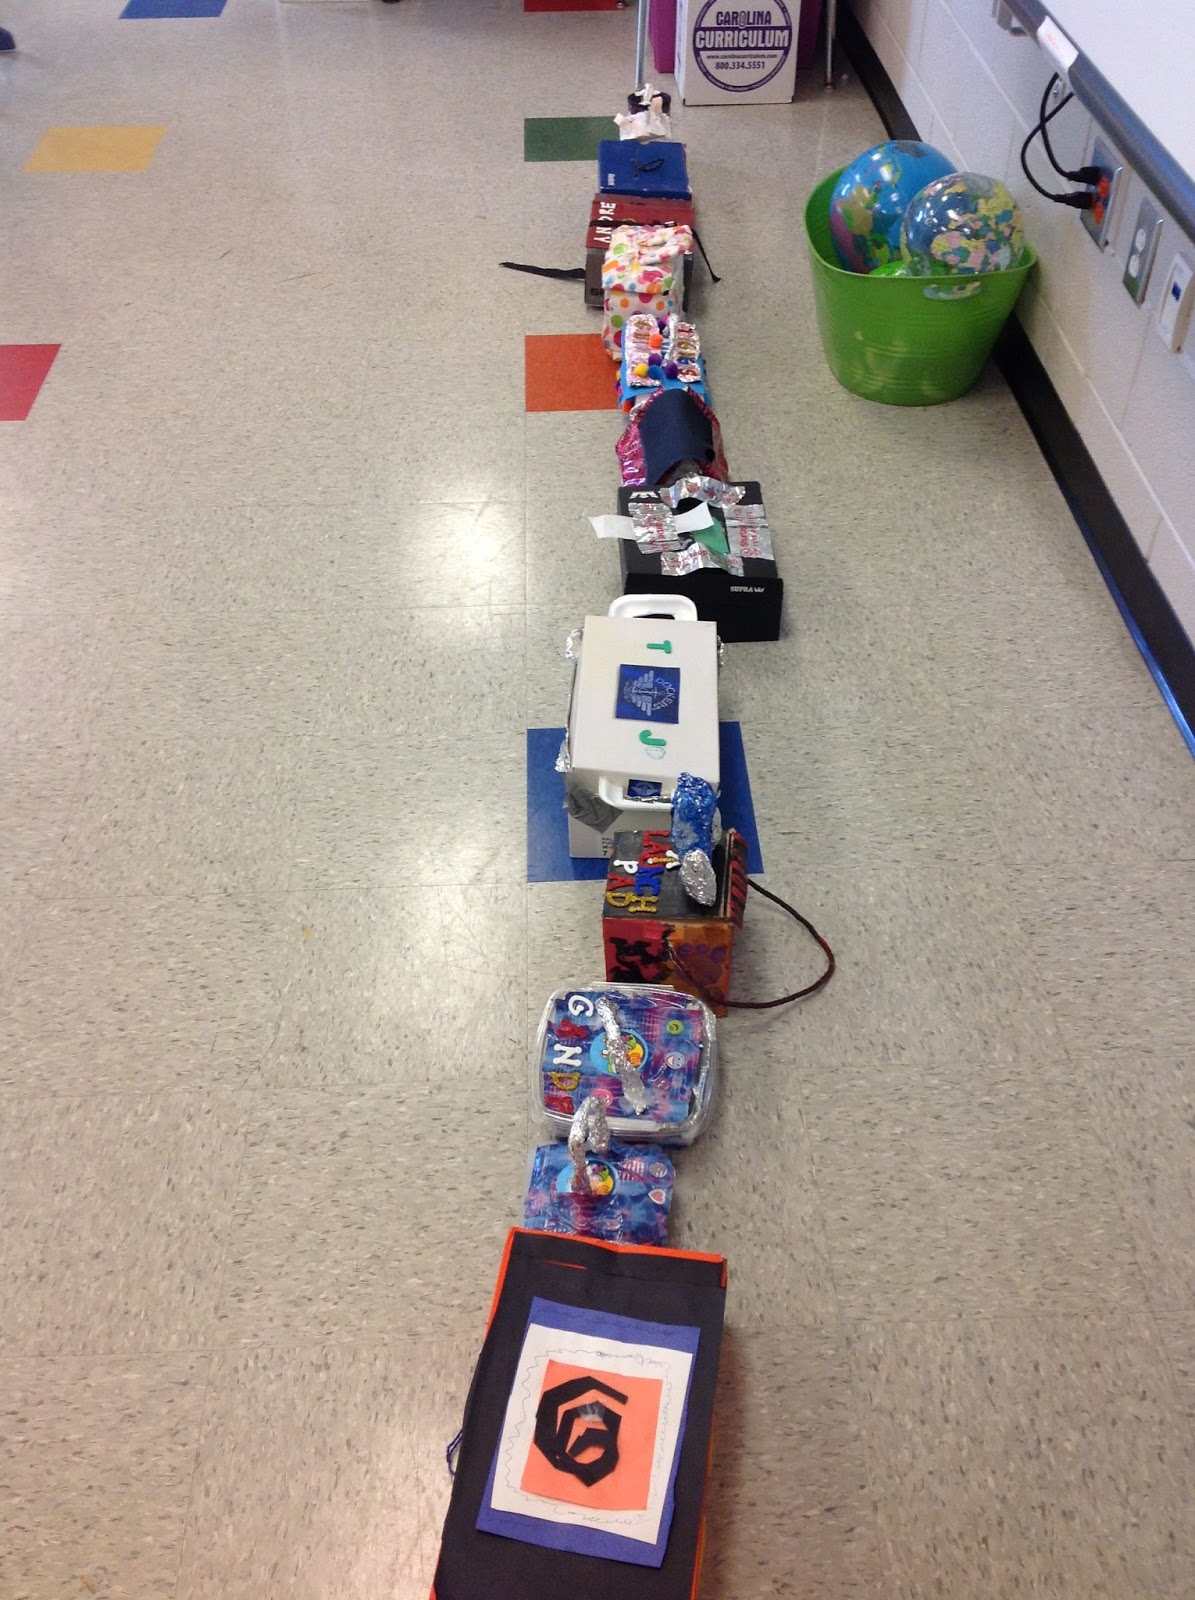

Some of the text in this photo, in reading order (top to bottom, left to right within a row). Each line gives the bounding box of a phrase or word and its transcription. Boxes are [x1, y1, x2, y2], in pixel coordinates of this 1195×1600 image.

[716, 11, 772, 27] CAROLINA
[695, 30, 789, 48] CURRICULUM
[715, 61, 765, 70] 800.334.5551
[730, 585, 754, 593] SUPRA
[652, 677, 676, 711] DOCKERS
[628, 830, 671, 913] LAUNCH
[606, 859, 639, 907] PAD
